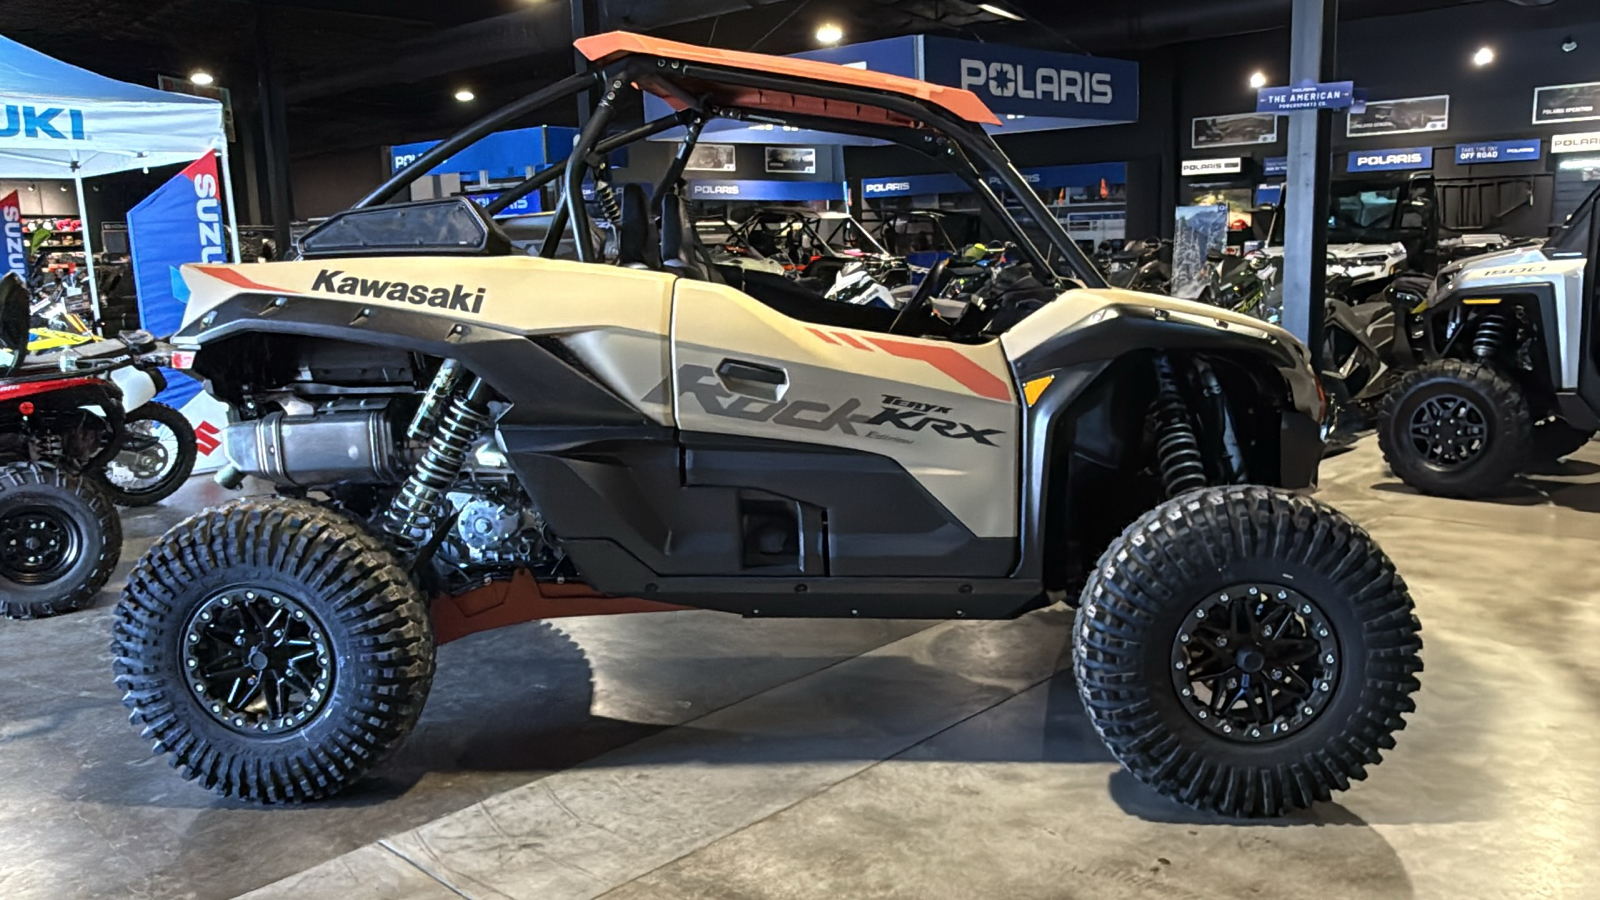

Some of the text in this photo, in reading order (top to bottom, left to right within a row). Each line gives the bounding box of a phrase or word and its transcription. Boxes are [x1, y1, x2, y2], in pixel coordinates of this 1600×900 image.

[960, 58, 1113, 104] POLARIS
[1268, 91, 1341, 104] THE AMERICAN
[1357, 153, 1422, 166] POLARIS
[1460, 151, 1498, 160] OFF ROAD
[1183, 162, 1222, 171] POLARIS
[694, 185, 739, 195] POLARIS
[866, 182, 910, 193] POLARIS
[311, 269, 487, 314] Kawasaki
[866, 406, 1006, 447] KRX
